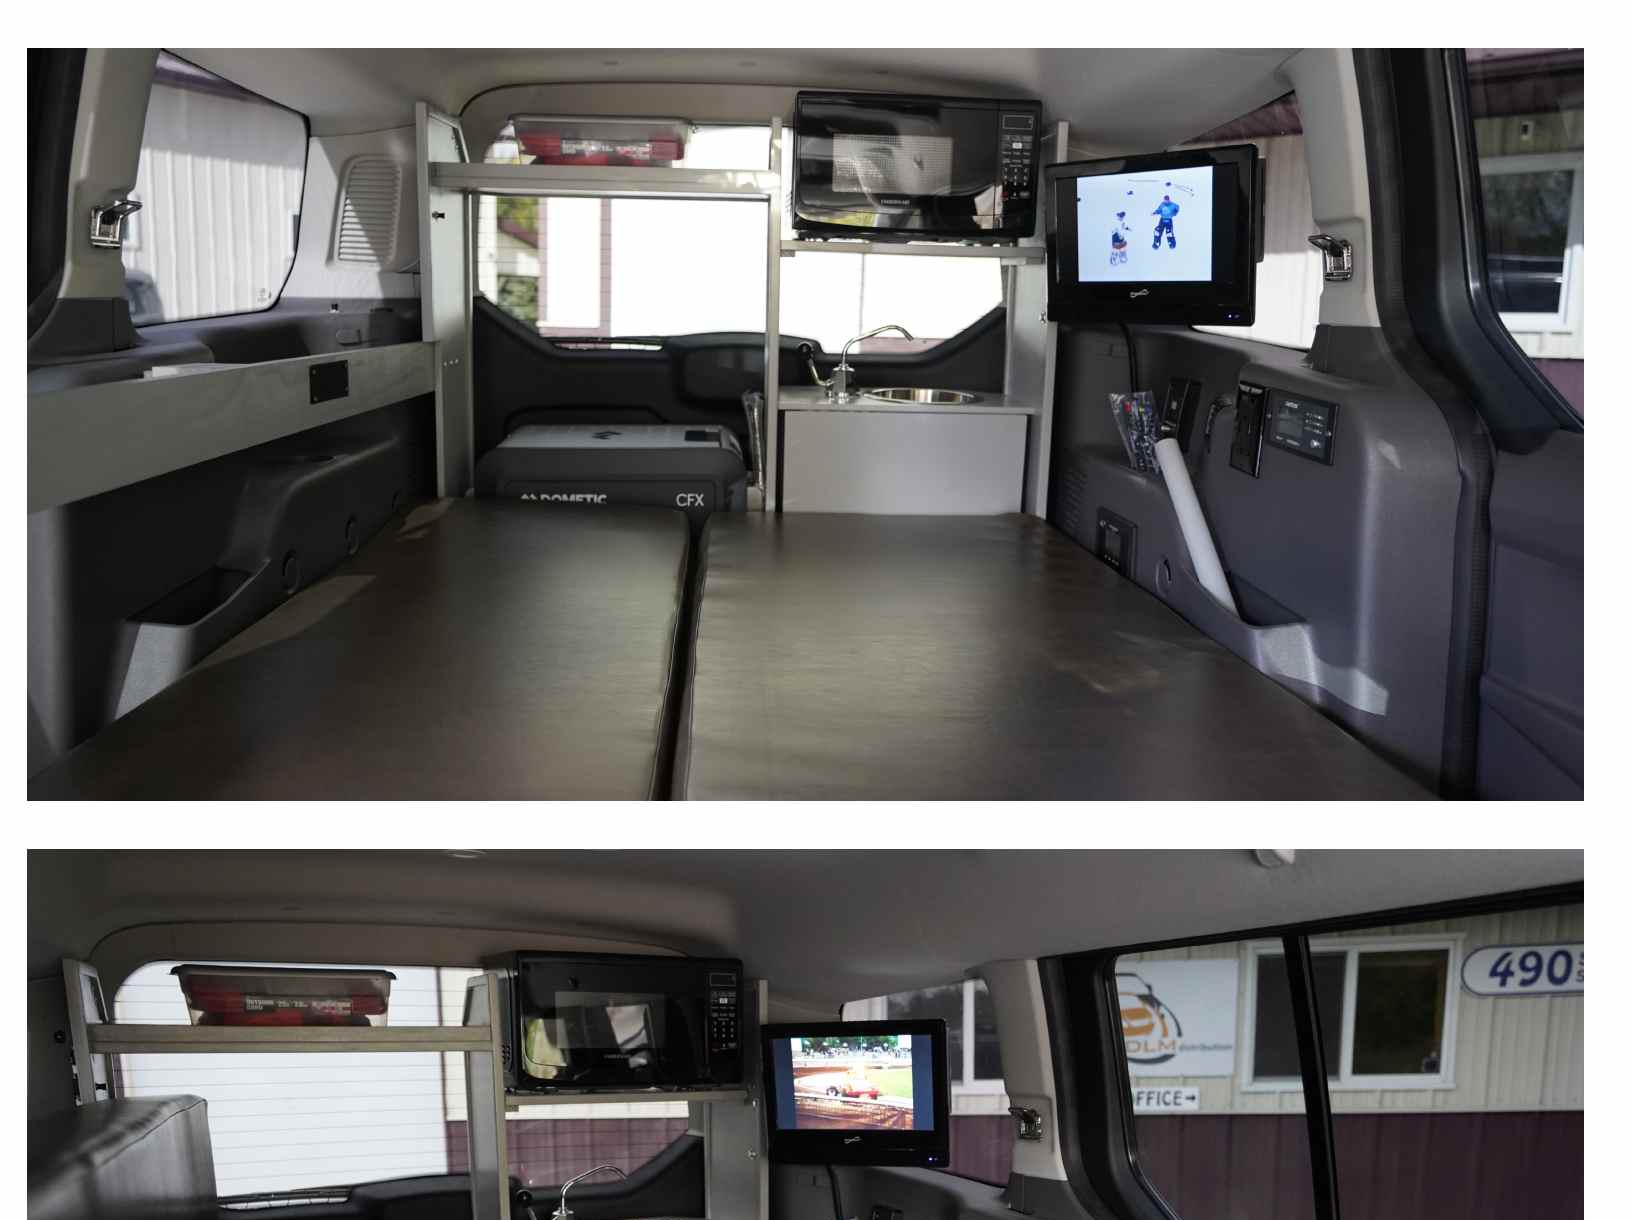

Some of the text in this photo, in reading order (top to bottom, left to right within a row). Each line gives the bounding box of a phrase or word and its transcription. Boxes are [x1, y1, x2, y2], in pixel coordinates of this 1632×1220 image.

[676, 493, 705, 507] CFX
[1489, 950, 1573, 988] 490
[1131, 1090, 1184, 1107] FFICE
